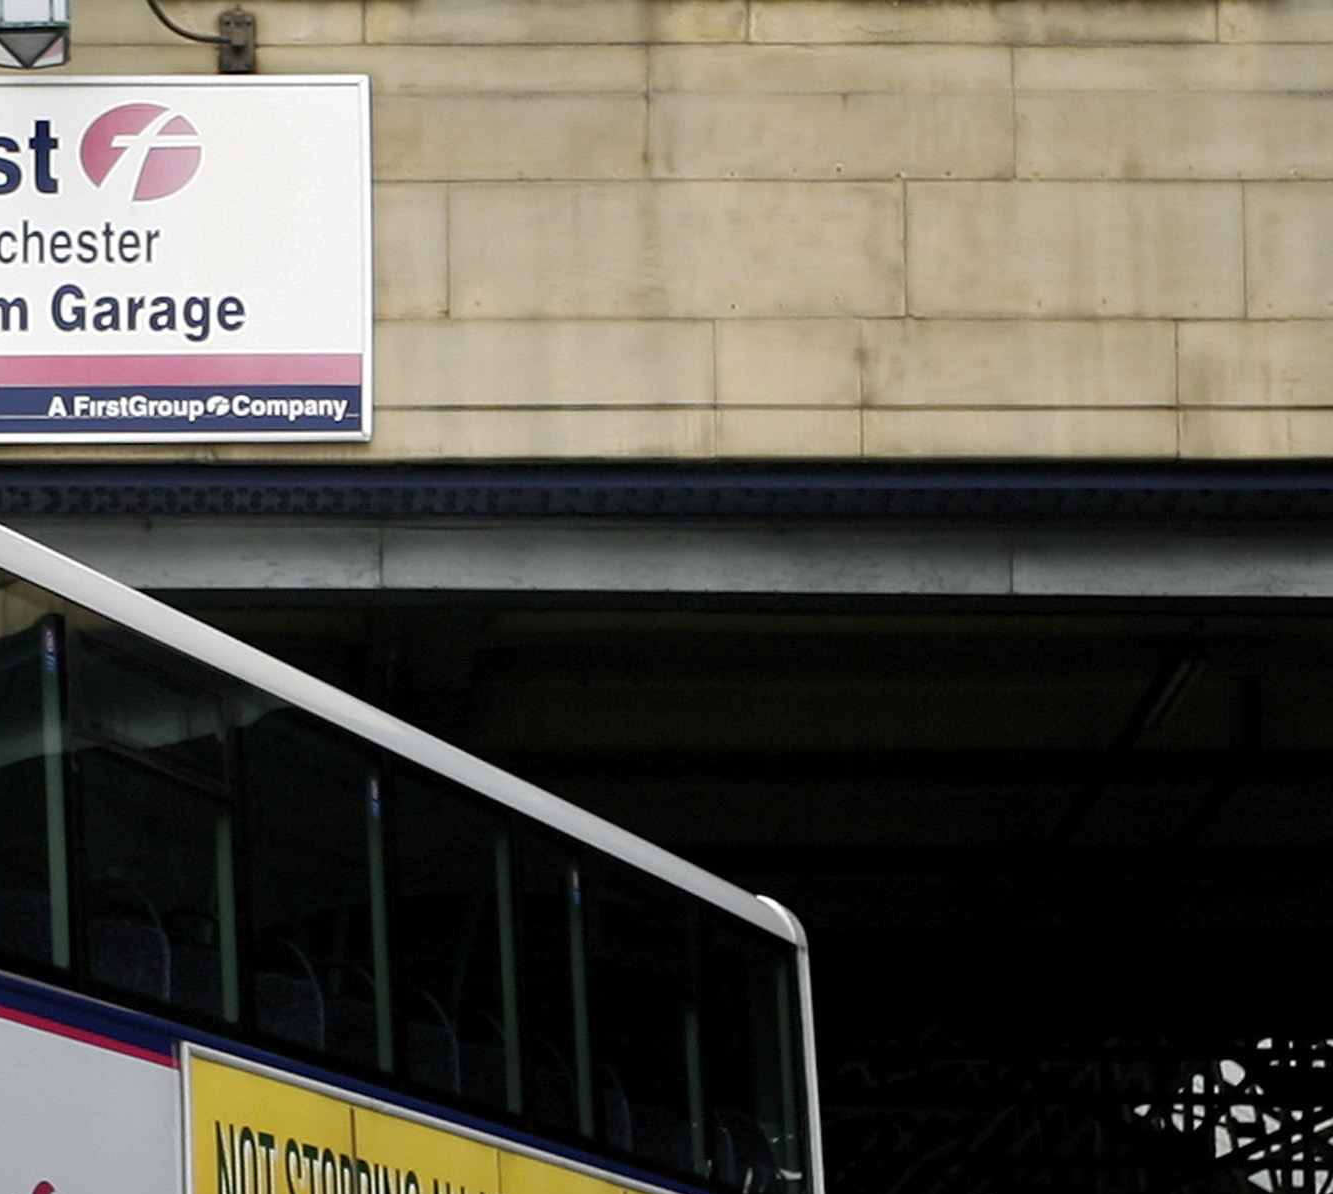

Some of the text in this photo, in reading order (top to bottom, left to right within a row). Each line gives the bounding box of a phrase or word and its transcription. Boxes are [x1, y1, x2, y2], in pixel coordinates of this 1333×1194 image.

[50, 283, 246, 342] Garage
[47, 395, 348, 422] A FirstGroup Company
